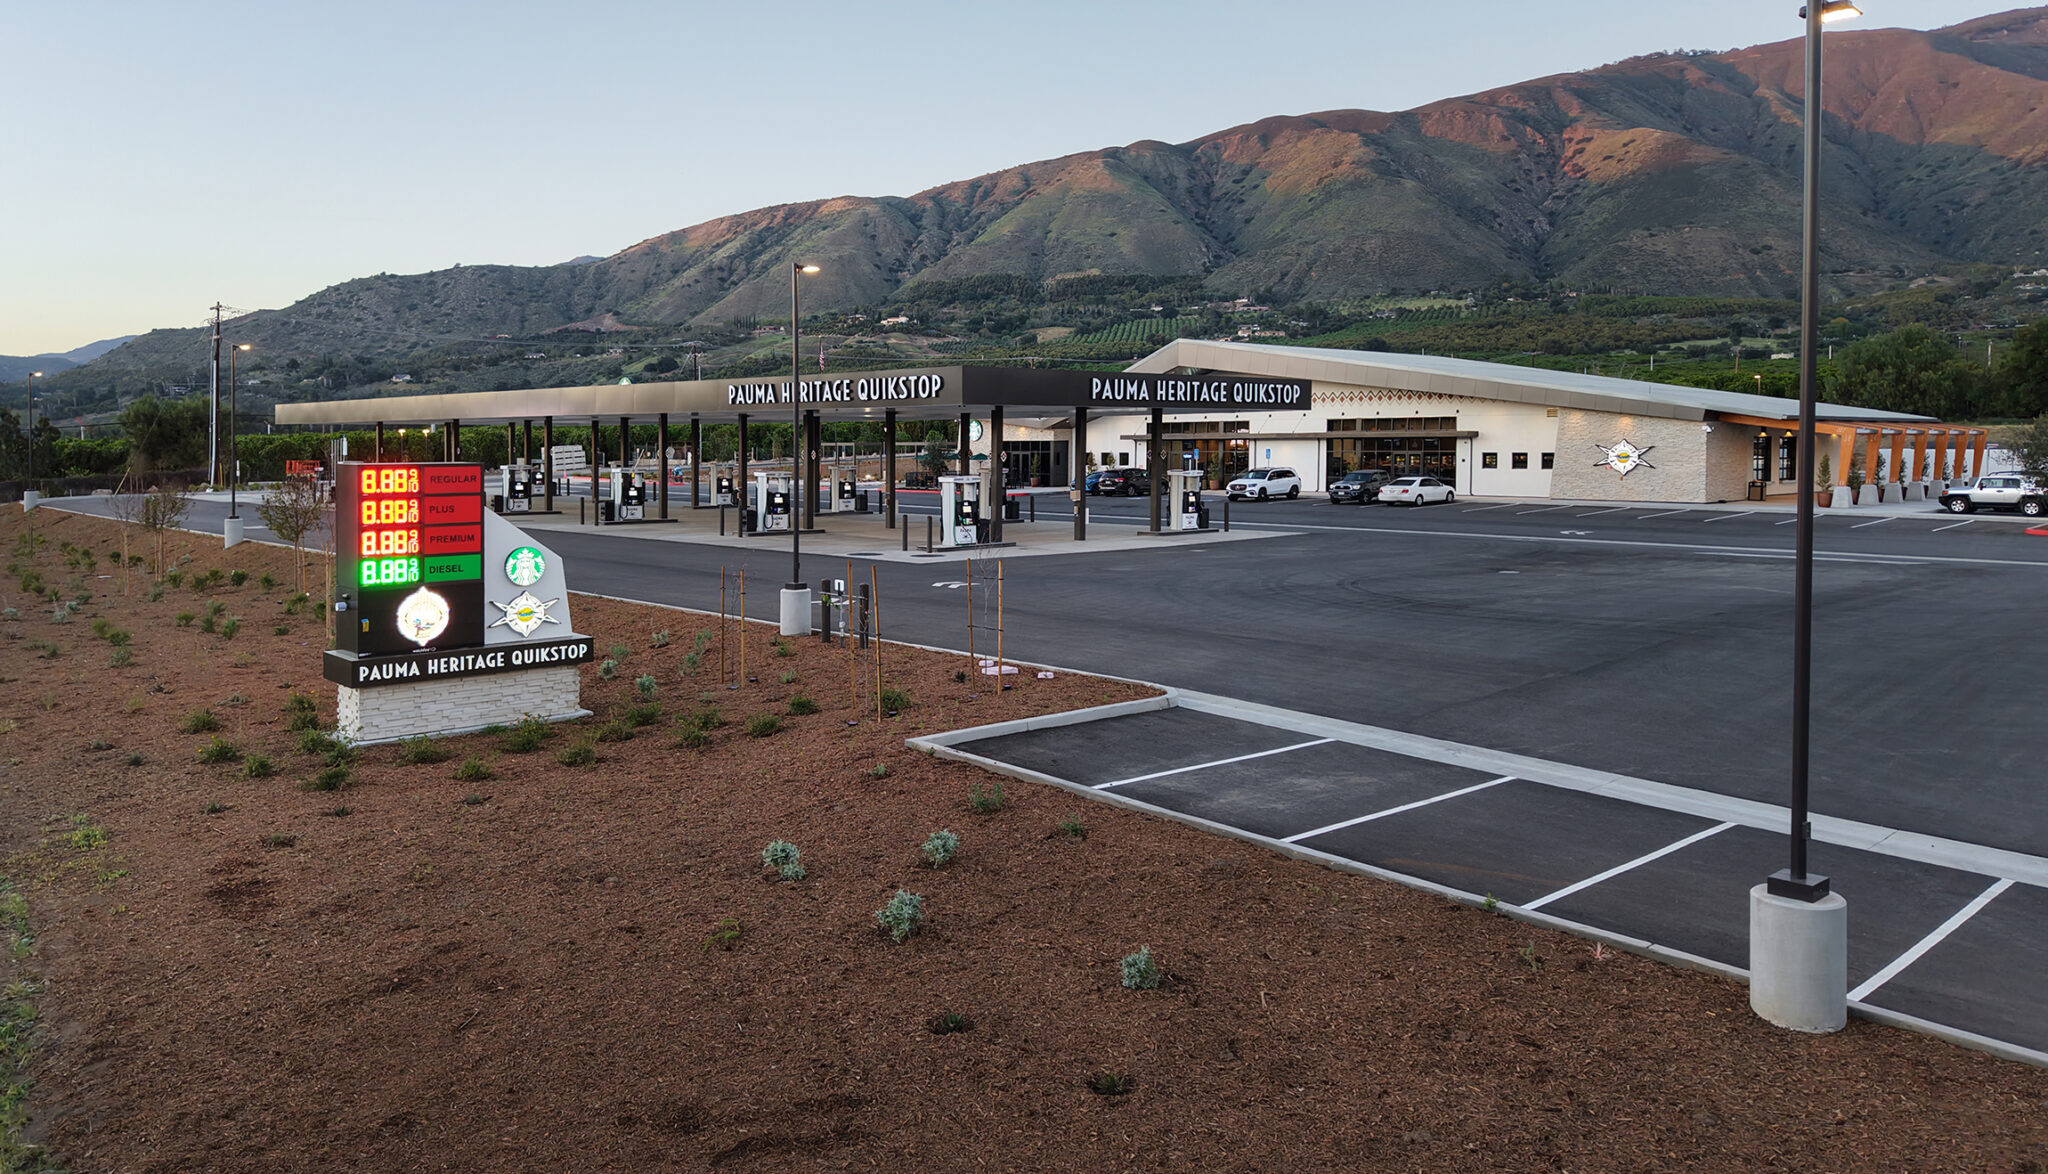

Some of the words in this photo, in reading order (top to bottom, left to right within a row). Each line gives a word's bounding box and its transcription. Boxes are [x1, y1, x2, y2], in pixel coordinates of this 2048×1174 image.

[728, 383, 775, 405] PAUMA
[781, 379, 851, 403] HRITAGE
[857, 374, 941, 401] QUIKSTOP
[1092, 377, 1149, 400] PAUMA
[1156, 380, 1228, 403] HERITAGE
[1233, 383, 1300, 404] QUIKSTOP
[361, 469, 408, 494] 8.88
[430, 475, 477, 484] REGULAR
[361, 500, 408, 525] 8.88
[429, 505, 455, 514] PLUS
[361, 530, 408, 556] 8.88
[429, 534, 475, 544] PREMIUM
[361, 559, 408, 585] 8.88
[429, 564, 464, 574] DIESEL
[359, 661, 421, 682] PAUMA
[427, 652, 505, 675] HERITAGE
[511, 643, 588, 665] QUIKSTOP
